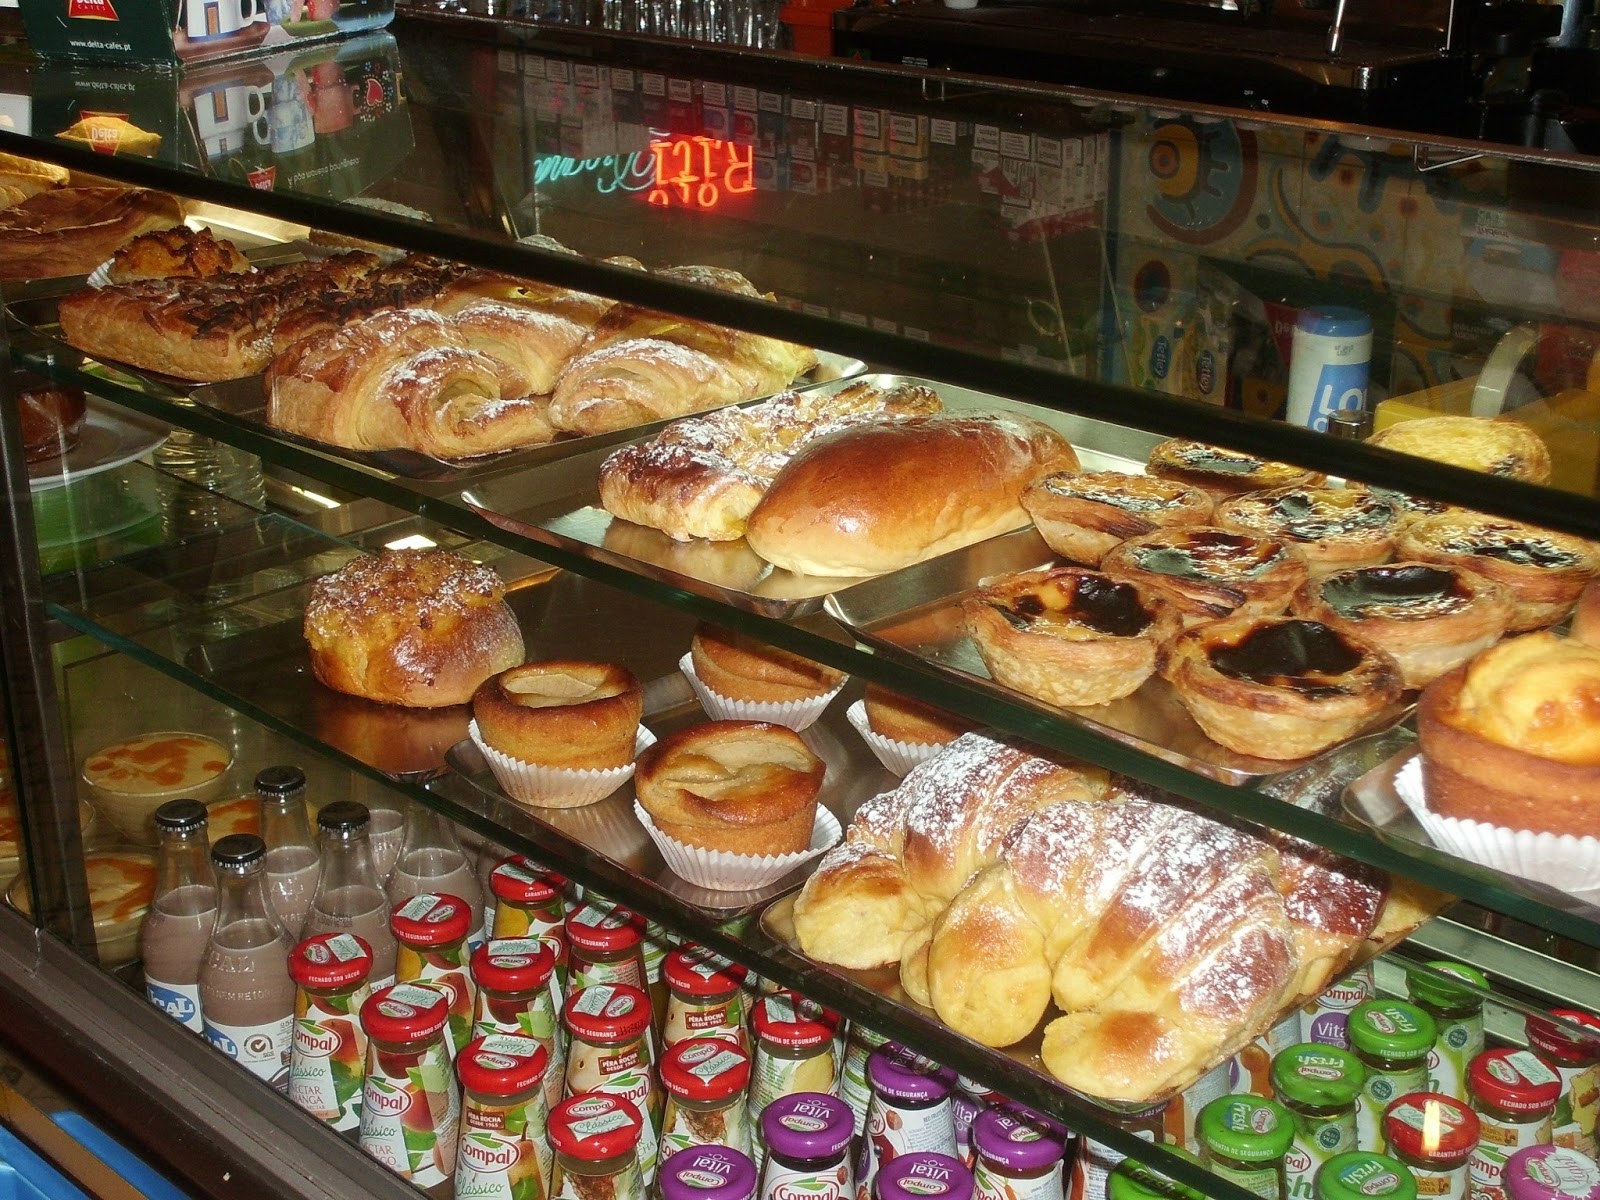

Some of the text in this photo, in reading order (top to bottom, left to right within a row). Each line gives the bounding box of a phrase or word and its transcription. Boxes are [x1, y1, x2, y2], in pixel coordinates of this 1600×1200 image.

[1155, 340, 1168, 379] Tetley
[1200, 355, 1213, 393] Tetley
[1318, 384, 1367, 416] LO
[1323, 987, 1364, 1002] ompal
[410, 1027, 433, 1039] FECHADO
[1317, 1022, 1346, 1036] Vita
[294, 1028, 332, 1051] ompal
[791, 1036, 821, 1045] SEGURANÇA
[681, 1045, 714, 1061] Compal
[1380, 1049, 1406, 1058] FECHADO
[366, 1086, 402, 1110] ompal
[896, 1090, 928, 1099] SEGURANÇA
[571, 1101, 611, 1113] Compal
[793, 1103, 830, 1119] Vital
[1500, 1099, 1527, 1109] FECHADO
[784, 1116, 821, 1130] Compal
[461, 1138, 511, 1166] Compal
[1240, 1149, 1274, 1157] SEGURANÇA
[692, 1157, 731, 1174] Vital
[910, 1164, 949, 1180] Vital
[682, 1171, 721, 1186] Compal
[903, 1178, 942, 1192] Compal
